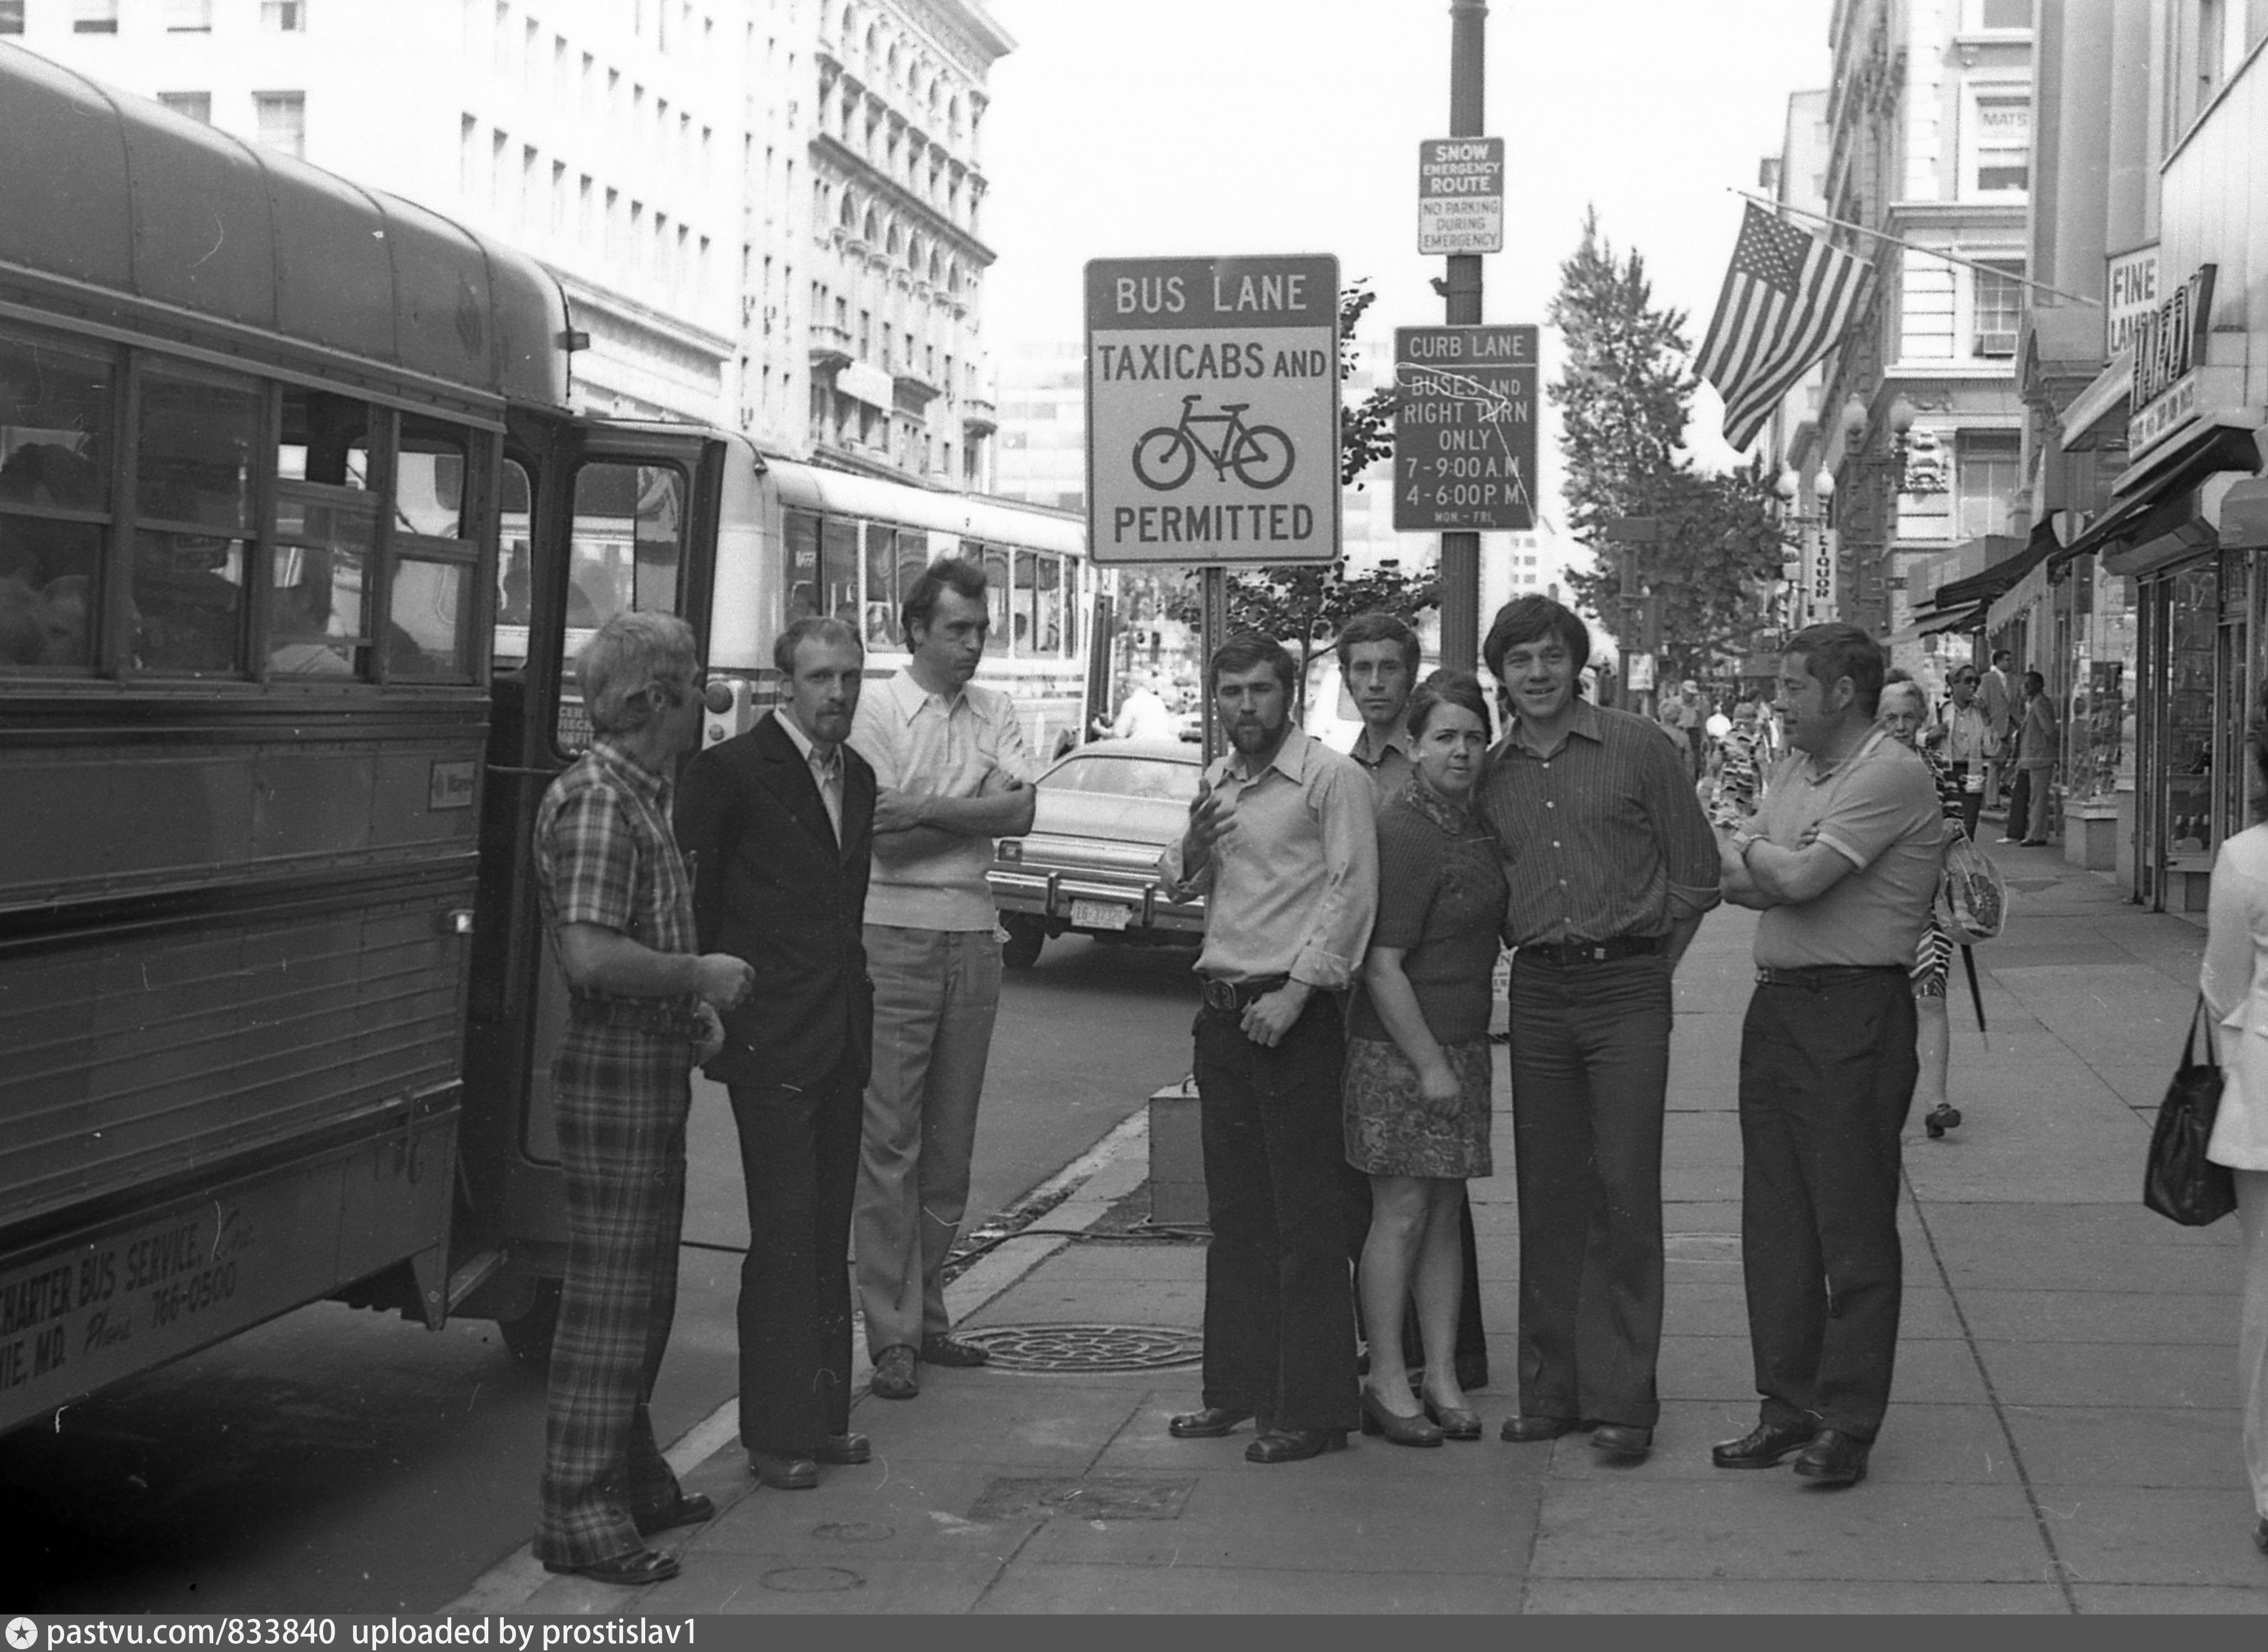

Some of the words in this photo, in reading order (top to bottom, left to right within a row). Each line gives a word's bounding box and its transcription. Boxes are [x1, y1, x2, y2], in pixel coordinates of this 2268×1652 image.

[1436, 144, 1489, 162] SNOW
[1423, 162, 1501, 175] EMERGENCY
[1431, 176, 1490, 193] ROUTE
[1423, 202, 1441, 215] NO
[1446, 199, 1498, 214] PARKING
[1437, 217, 1485, 231] DURING
[1423, 233, 1498, 248] EMERGENCY
[1116, 276, 1185, 313] BUS
[1214, 274, 1307, 312] LANE
[2113, 259, 2155, 308] FINE
[1410, 335, 1462, 357] CURB
[1472, 335, 1525, 357] LANE
[1098, 342, 1265, 380] TAXICABS
[1273, 350, 1326, 378] AND
[1412, 375, 1478, 397] BUSES
[1490, 379, 1520, 396] AND
[1404, 402, 1465, 424] RIGHT
[1474, 401, 1528, 423] TURN
[1439, 429, 1491, 451] ONLY
[1115, 504, 1314, 543] PERMITTED
[80, 1250, 115, 1308] BUS
